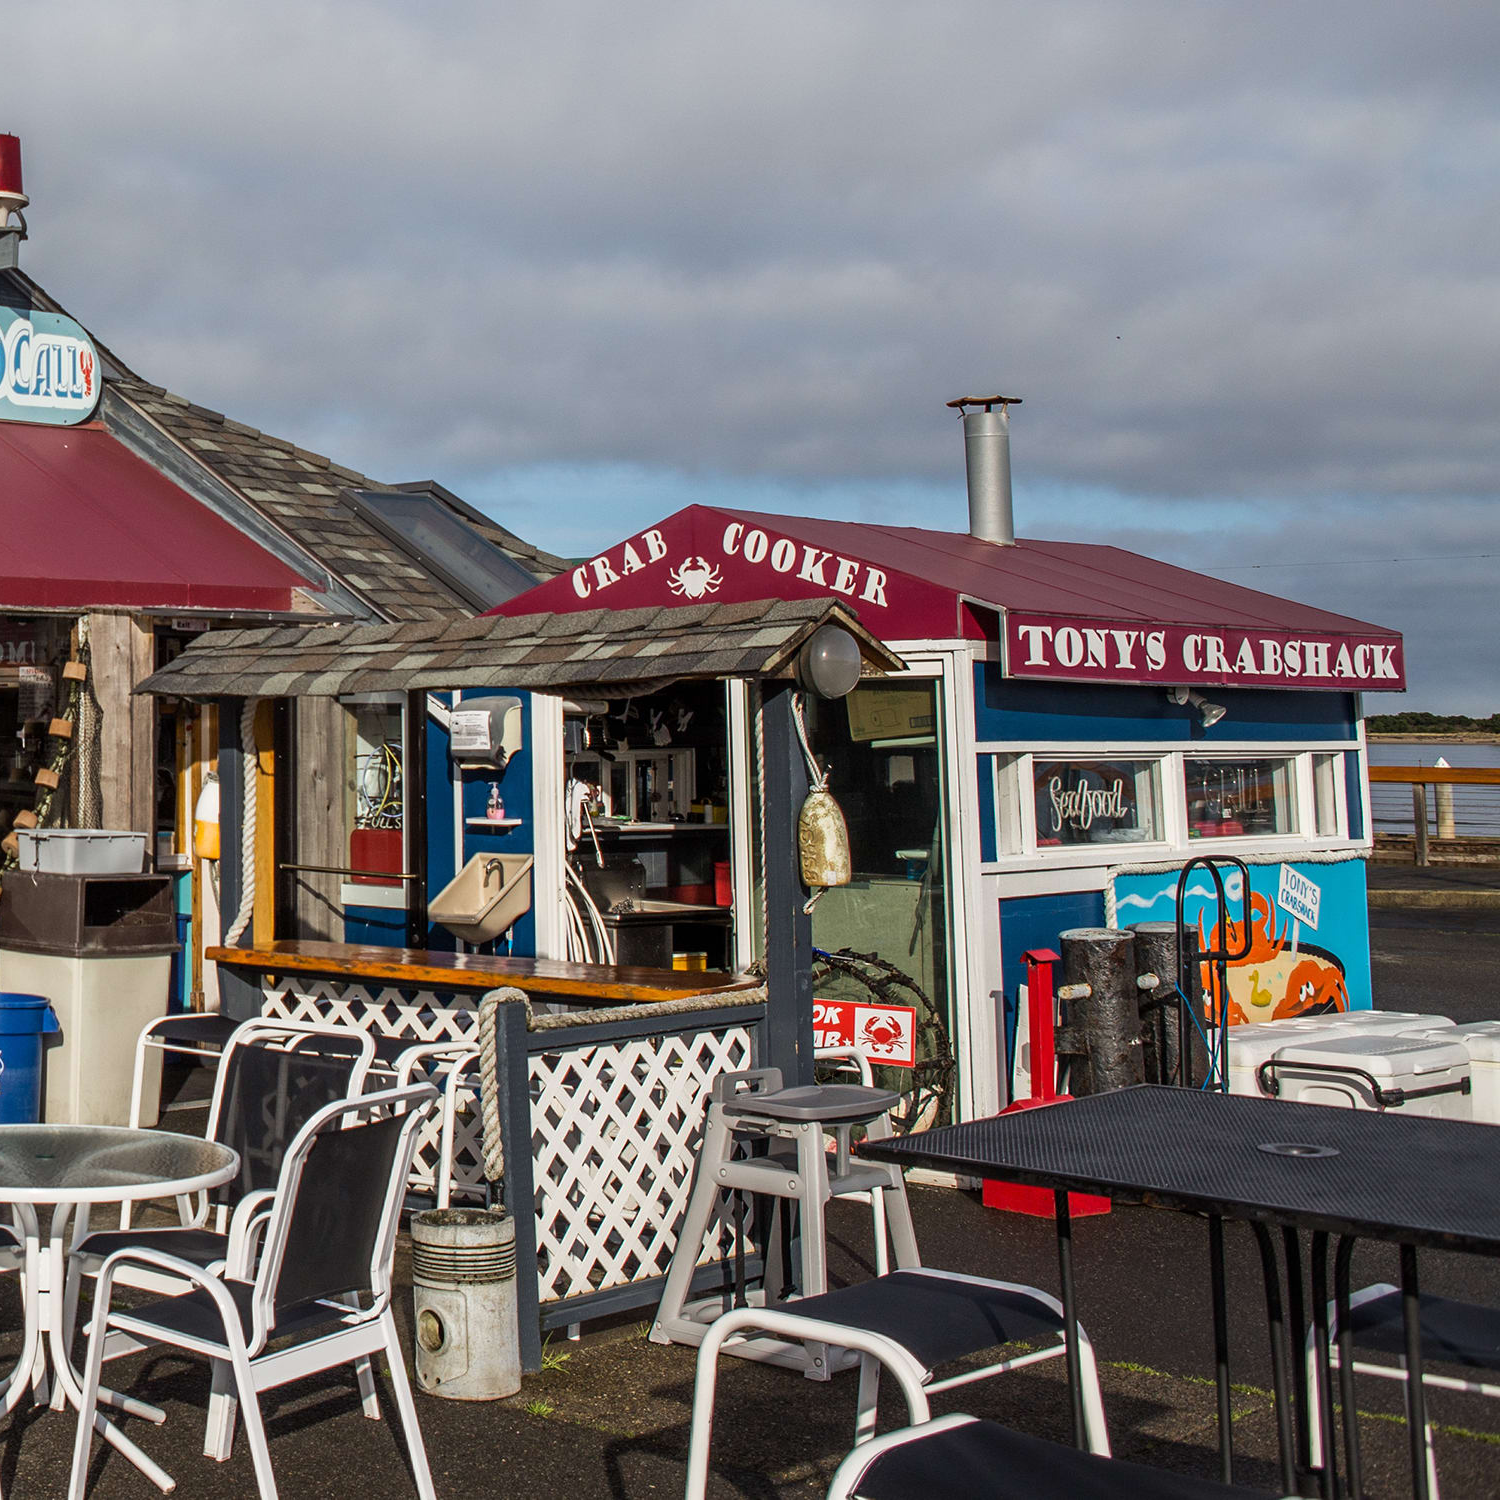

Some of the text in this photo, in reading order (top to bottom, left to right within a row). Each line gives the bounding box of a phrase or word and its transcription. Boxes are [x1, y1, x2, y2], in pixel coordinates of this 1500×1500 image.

[11, 328, 83, 399] CALL
[572, 522, 888, 608] CRAB COOKER
[1018, 624, 1400, 679] TONY'S CRABSHACK
[1050, 776, 1128, 832] Seafood
[1284, 867, 1318, 906] TONY'S
[813, 1005, 843, 1025] OK
[813, 1030, 841, 1047] AB
